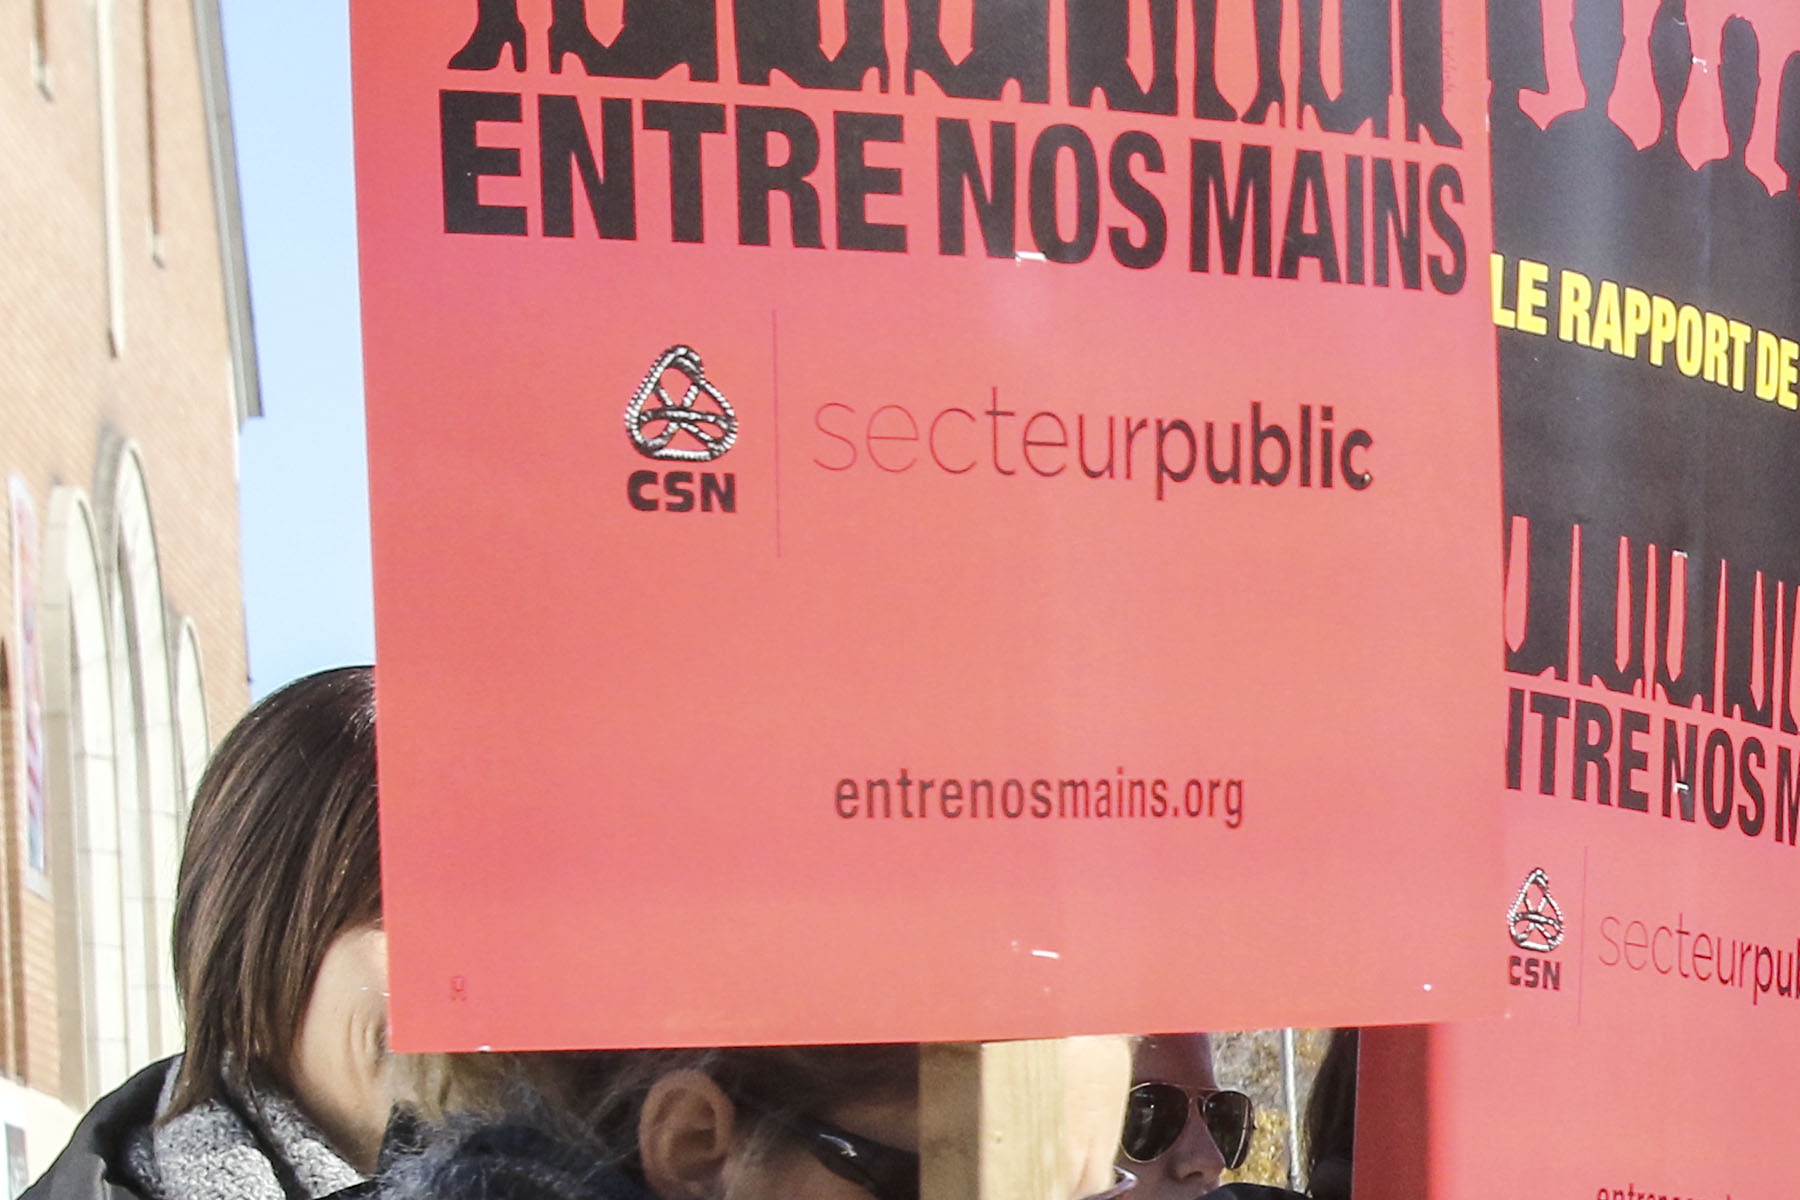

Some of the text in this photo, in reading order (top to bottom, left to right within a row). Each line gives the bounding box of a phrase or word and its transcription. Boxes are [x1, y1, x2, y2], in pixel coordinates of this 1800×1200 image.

[439, 89, 1467, 296] ENTRE NOS MAINS
[1491, 253, 1549, 336] LE
[1558, 269, 1751, 393] RAPPORT
[1754, 329, 1800, 411] DE
[626, 470, 736, 513] CSN
[812, 385, 1374, 501] secteurpublic
[834, 767, 1244, 828] entrenosmains.org
[1662, 716, 1767, 838] NOS
[1509, 955, 1561, 990] CSN
